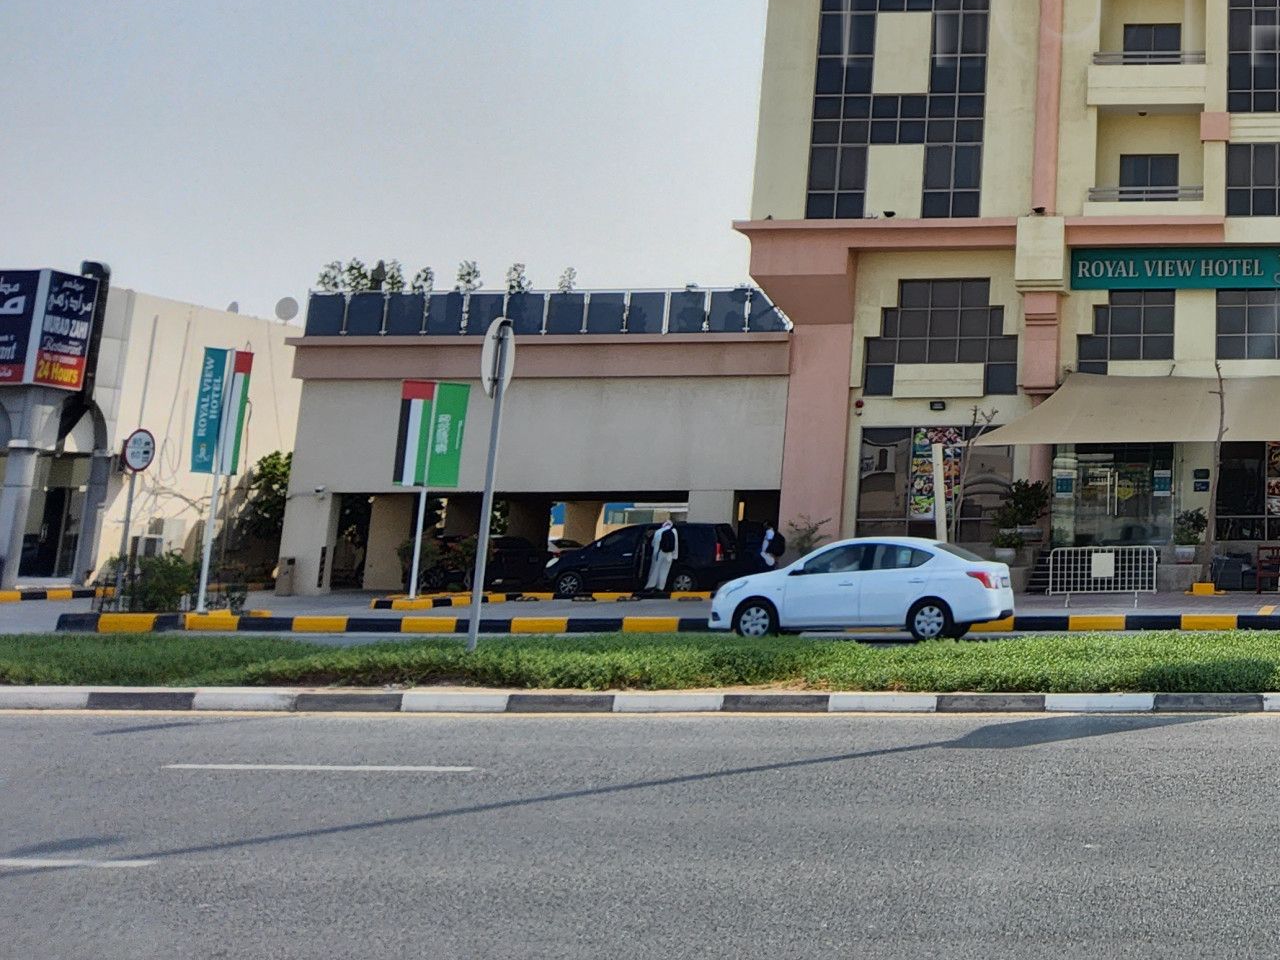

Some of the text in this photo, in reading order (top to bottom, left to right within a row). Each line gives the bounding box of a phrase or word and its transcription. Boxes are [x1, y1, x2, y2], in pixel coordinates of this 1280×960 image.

[1077, 259, 1264, 278] ROYAL VIEW HOTEL
[37, 360, 50, 380] 24
[51, 362, 79, 384] Hours
[202, 356, 215, 393] VIEW
[209, 376, 222, 419] HOTEL
[197, 396, 210, 437] ROYAL
